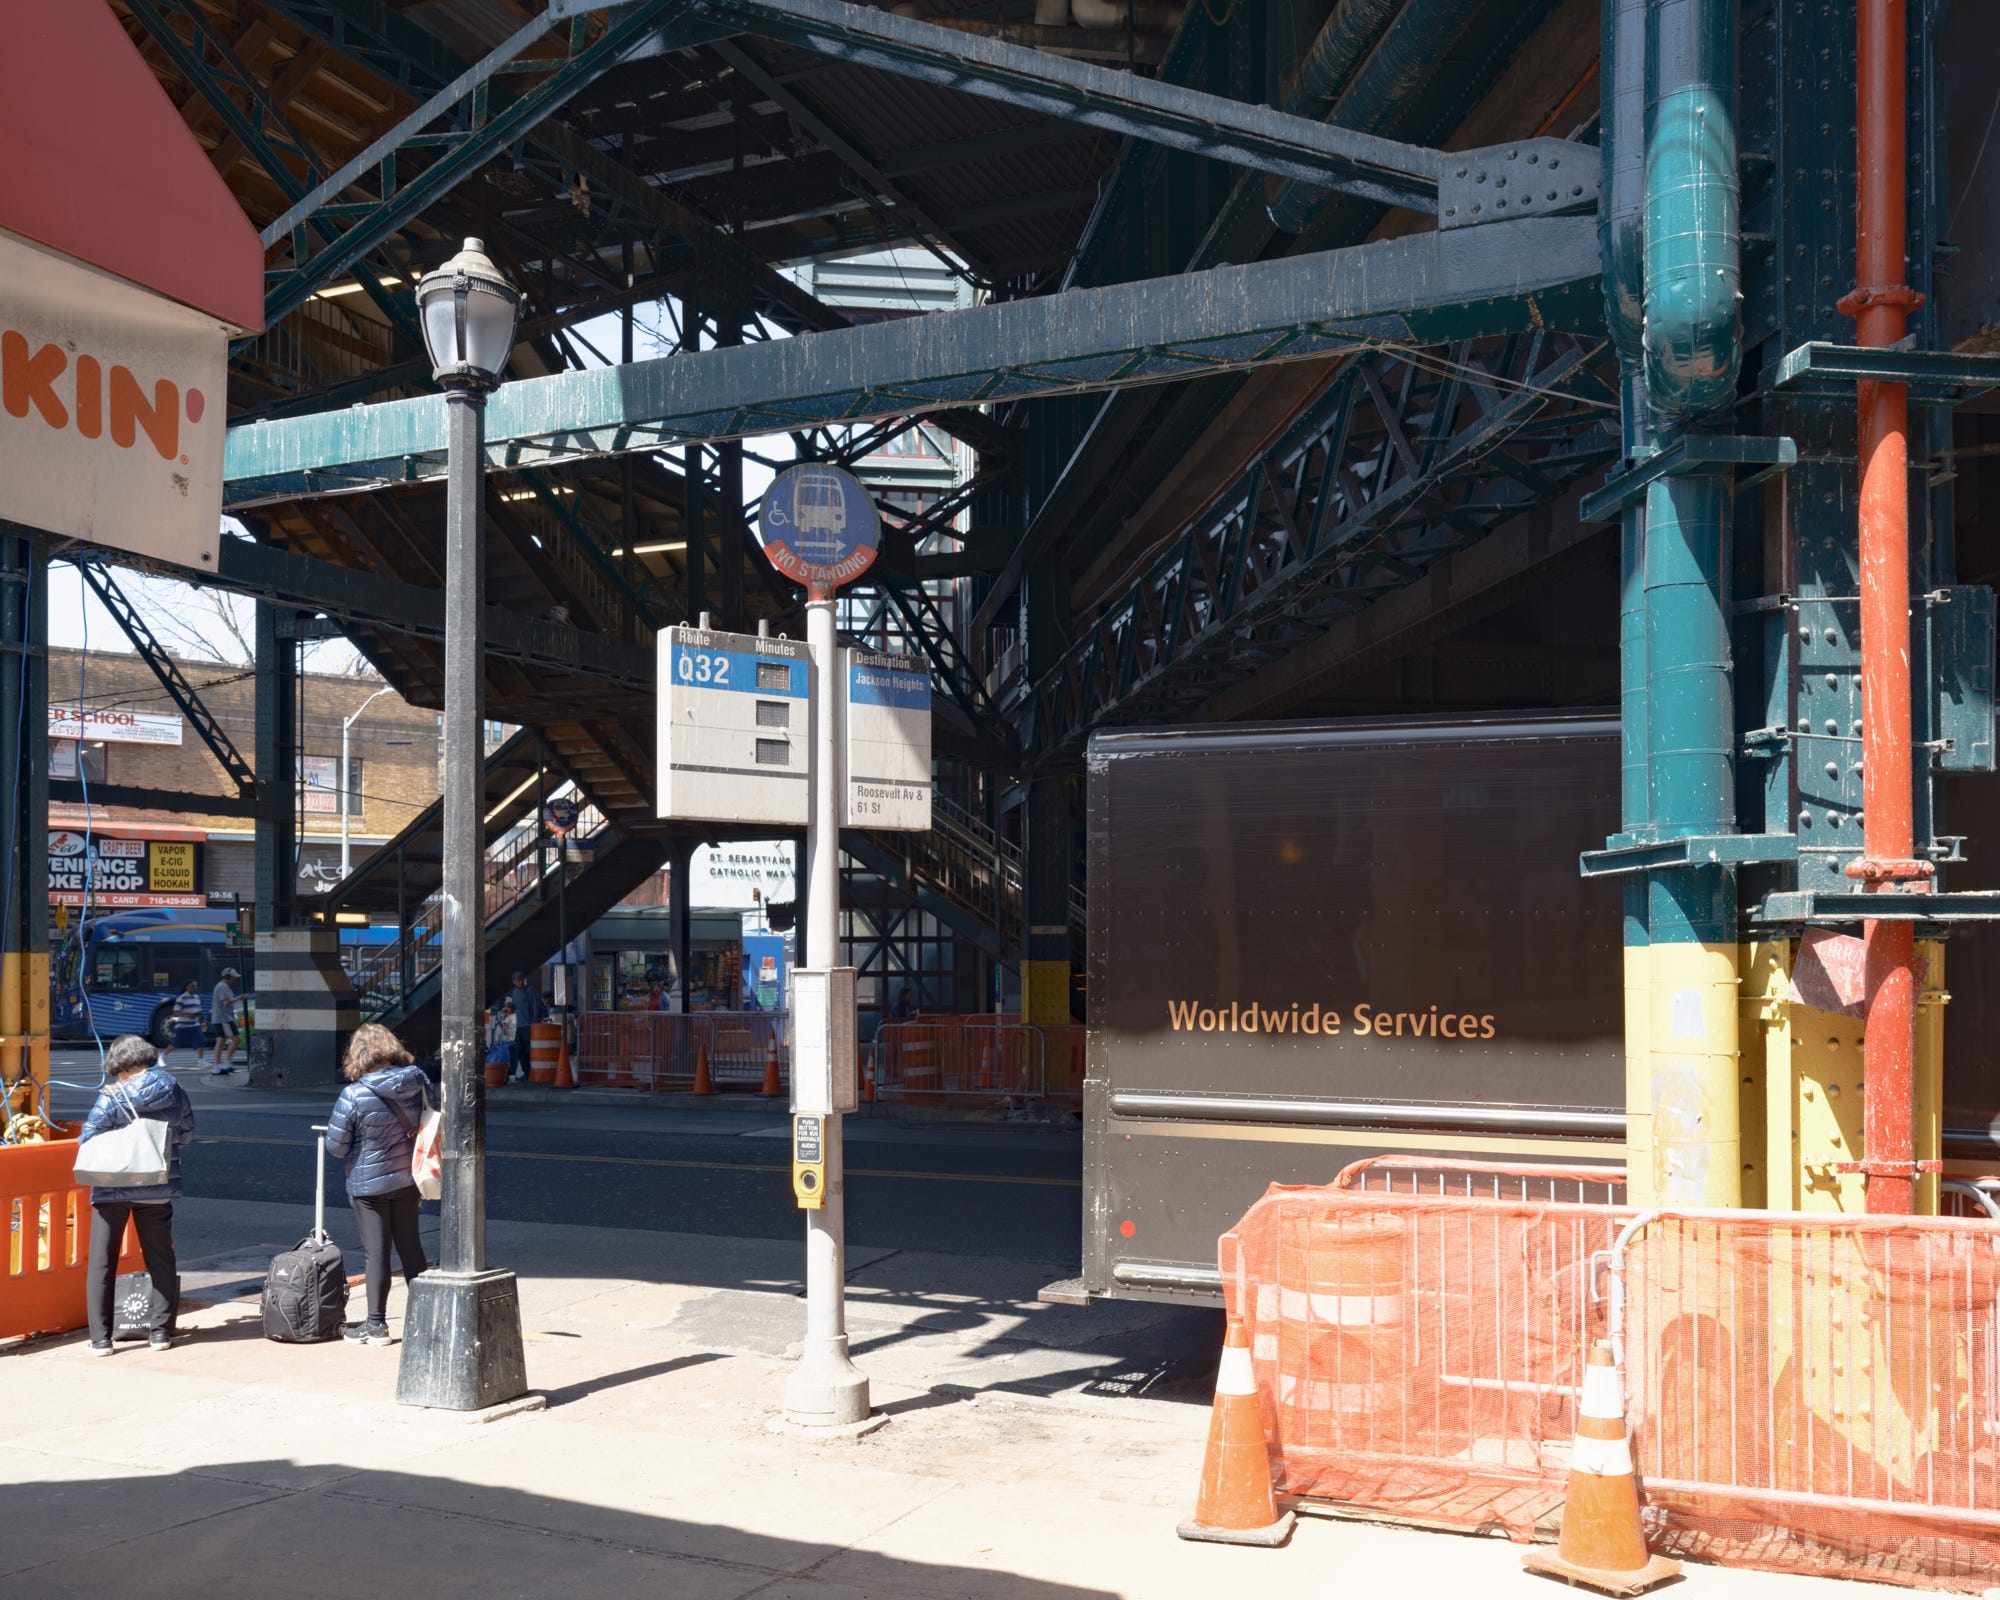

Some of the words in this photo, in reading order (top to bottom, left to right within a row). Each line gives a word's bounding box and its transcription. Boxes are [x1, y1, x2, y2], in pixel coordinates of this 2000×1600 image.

[775, 548, 796, 569] NO
[798, 551, 868, 580] STANDING
[679, 630, 711, 646] Route
[755, 640, 796, 656] Minutes
[856, 652, 910, 669] Destination
[678, 654, 730, 684] Q32
[855, 672, 890, 687] Jackson
[893, 675, 925, 692] Heights
[71, 709, 140, 727] SCHOOL
[857, 785, 901, 799] Roosevelt
[903, 788, 914, 800] Av
[916, 790, 923, 800] &
[857, 801, 868, 813] 61
[871, 802, 881, 814] St
[102, 841, 124, 854] CRAFT
[125, 842, 142, 855] BEER
[157, 846, 186, 855] VAPOR
[48, 856, 137, 874] ENINCE
[160, 857, 183, 866] E-CIG
[728, 854, 792, 865] SEBASTIANS
[153, 868, 190, 877] E-LIQUID
[709, 867, 760, 877] CATHOLIC
[766, 870, 786, 878] WAR
[88, 875, 144, 890] SHOP
[153, 879, 190, 888] HOOKAH
[112, 896, 139, 904] CANDY
[1168, 1000, 1341, 1035] Worldwide
[1353, 1003, 1496, 1039] Services
